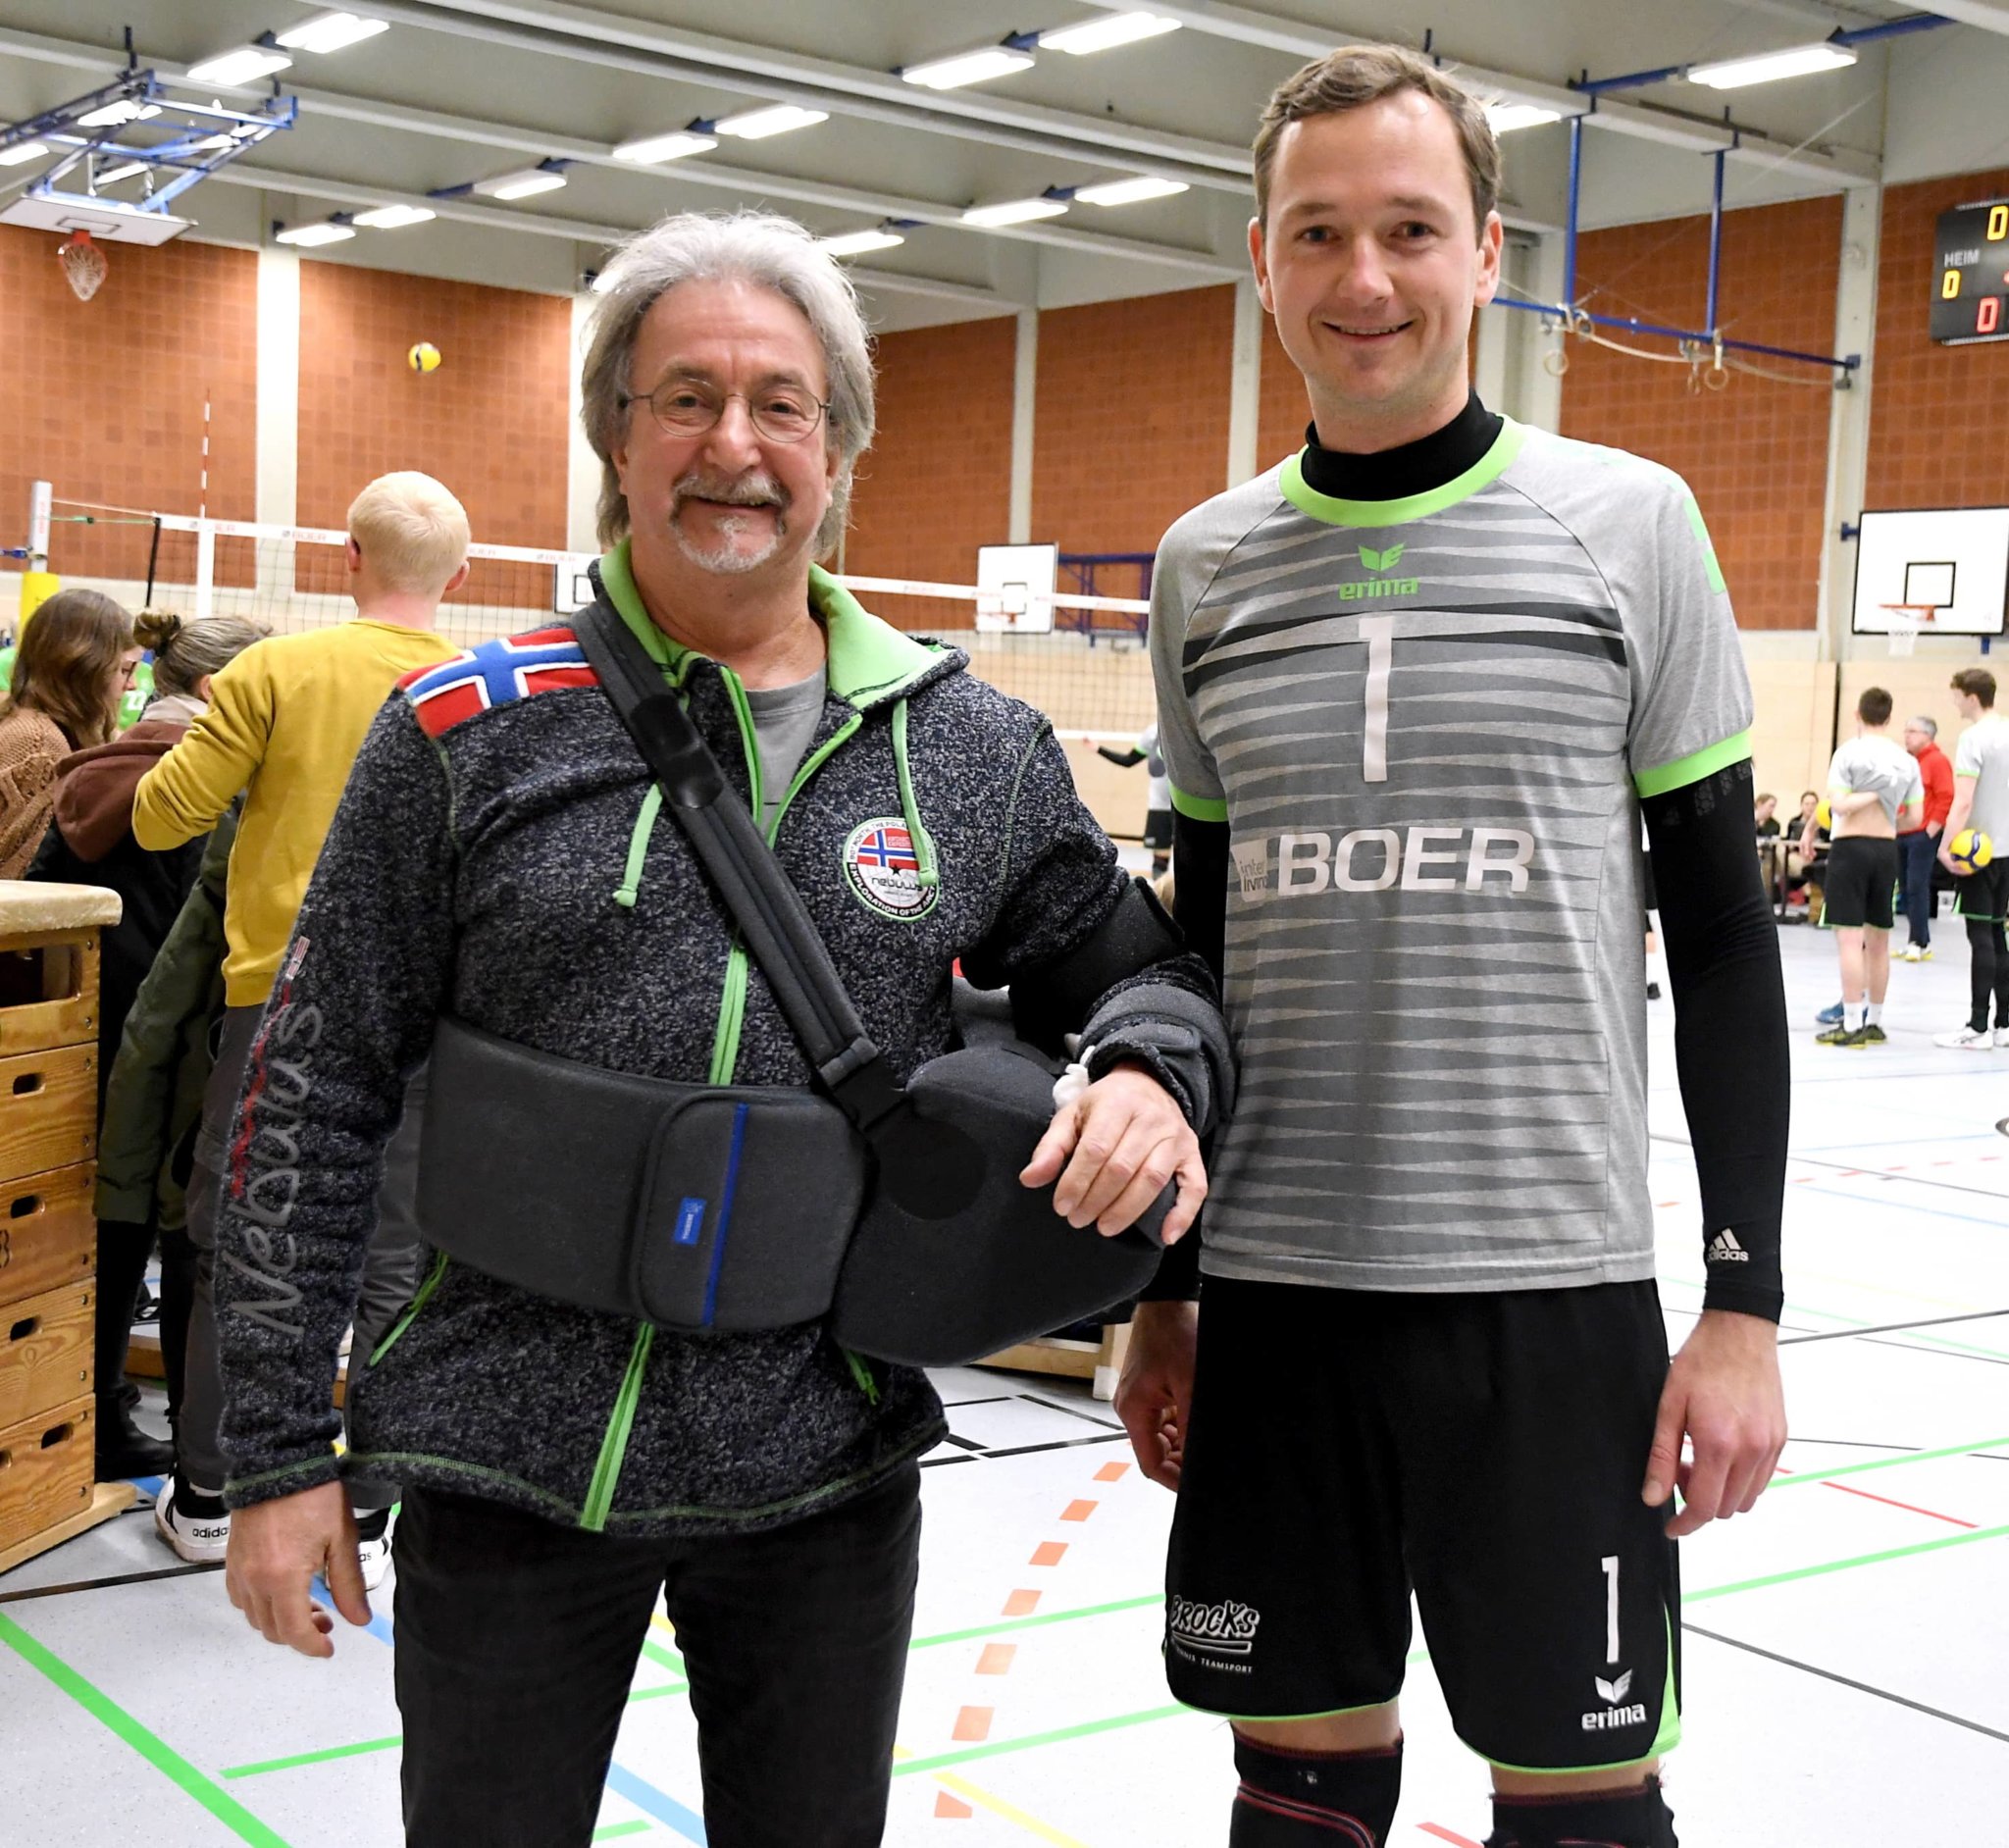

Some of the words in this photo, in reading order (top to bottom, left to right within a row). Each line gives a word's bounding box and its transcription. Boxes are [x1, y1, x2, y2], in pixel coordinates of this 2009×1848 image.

[1987, 205, 2009, 241] 0
[1943, 248, 1980, 268] HEIM
[1941, 269, 1961, 299] 0
[1976, 296, 1999, 334] 0
[1339, 577, 1419, 601] erima
[1359, 615, 1396, 783] 1
[1277, 826, 1535, 897] BOER
[850, 863, 899, 914] EXPLORATION
[922, 886, 936, 907] ARCT
[223, 1002, 323, 1335] Nebulus
[1708, 1248, 1749, 1262] didas
[192, 1526, 229, 1539] adida
[1170, 1594, 1261, 1638] BROCKS
[1601, 1555, 1620, 1664] 1
[1201, 1657, 1253, 1673] TEAMSPORT
[1581, 1703, 1648, 1732] erima
